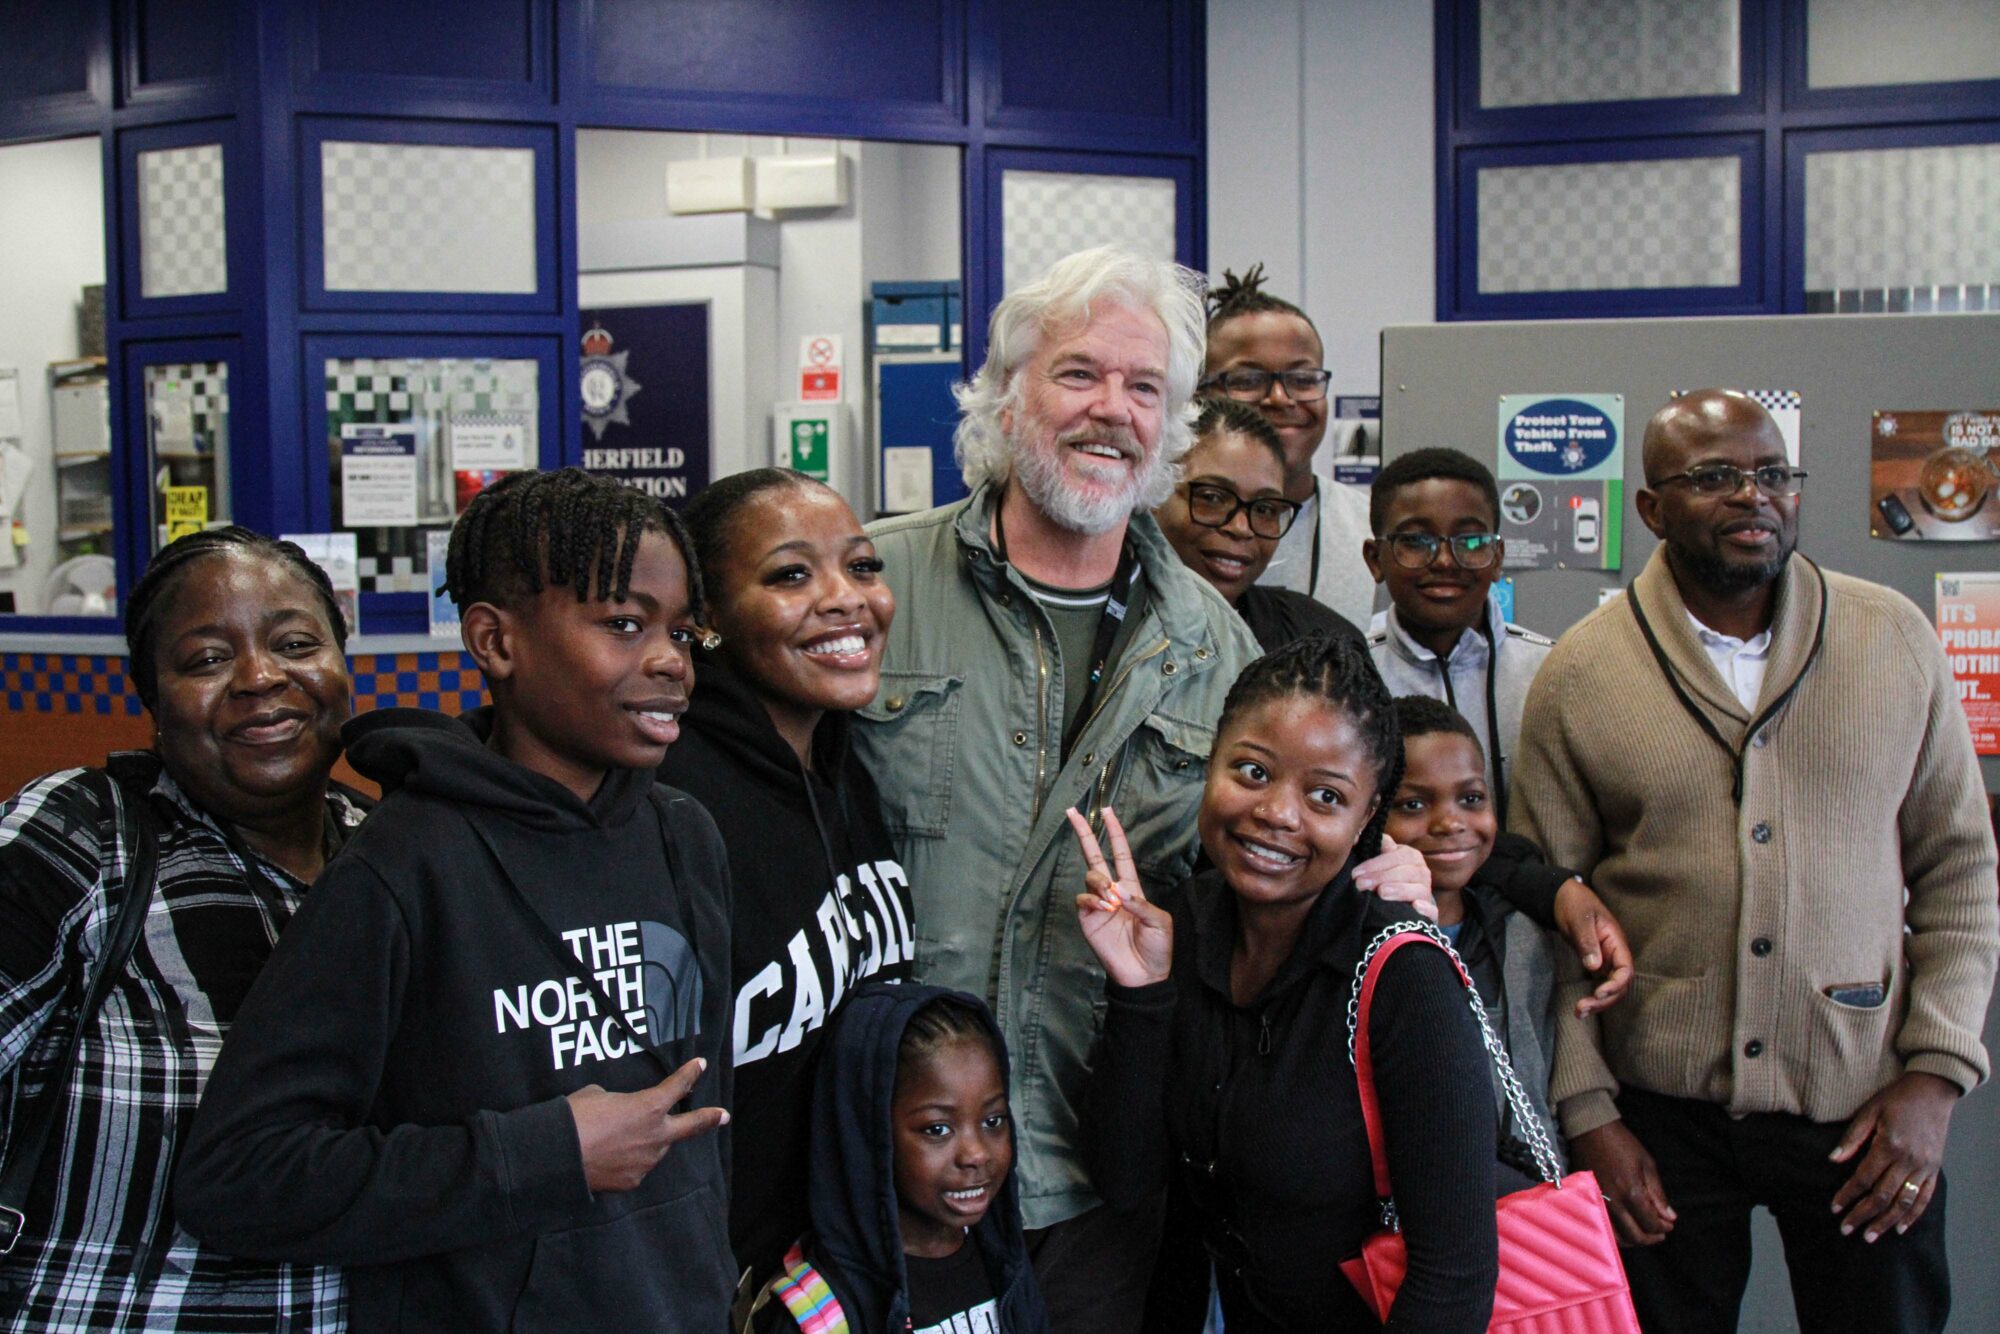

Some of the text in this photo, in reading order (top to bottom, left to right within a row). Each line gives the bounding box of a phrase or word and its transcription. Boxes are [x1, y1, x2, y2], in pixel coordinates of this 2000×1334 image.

[1514, 414, 1604, 426] Protect Your
[1514, 428, 1607, 439] Vehicle From
[1951, 423, 1992, 436] IS NOT
[1514, 441, 1557, 452] Theft.
[1951, 436, 1979, 448] BAD
[1941, 604, 1976, 623] IT'S
[1949, 654, 1999, 674] OTHI
[561, 921, 642, 970] THE
[493, 965, 645, 1034] NORTH
[550, 1009, 648, 1070] FACE
